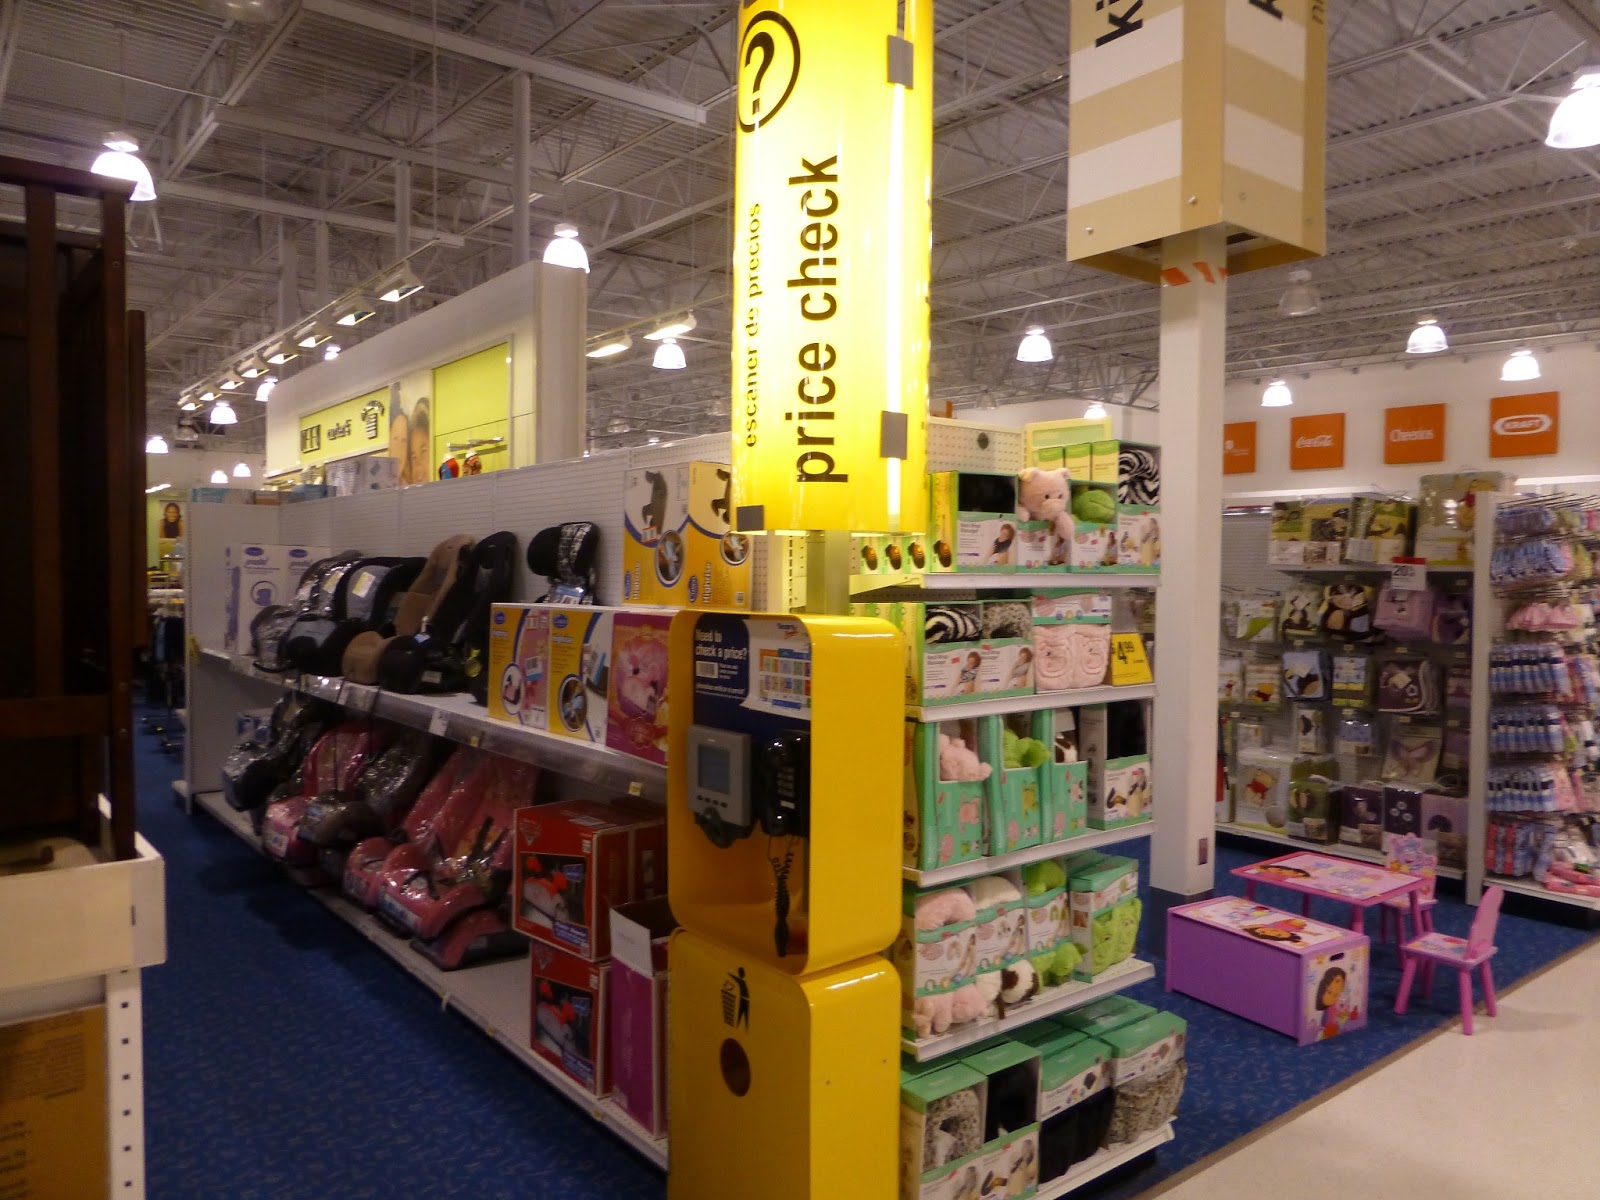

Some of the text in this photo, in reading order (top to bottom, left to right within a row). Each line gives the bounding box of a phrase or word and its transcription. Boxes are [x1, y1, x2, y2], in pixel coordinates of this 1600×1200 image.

[748, 202, 762, 298] precios
[745, 308, 760, 338] de
[785, 154, 848, 484] price check
[695, 643, 748, 661] check a price?
